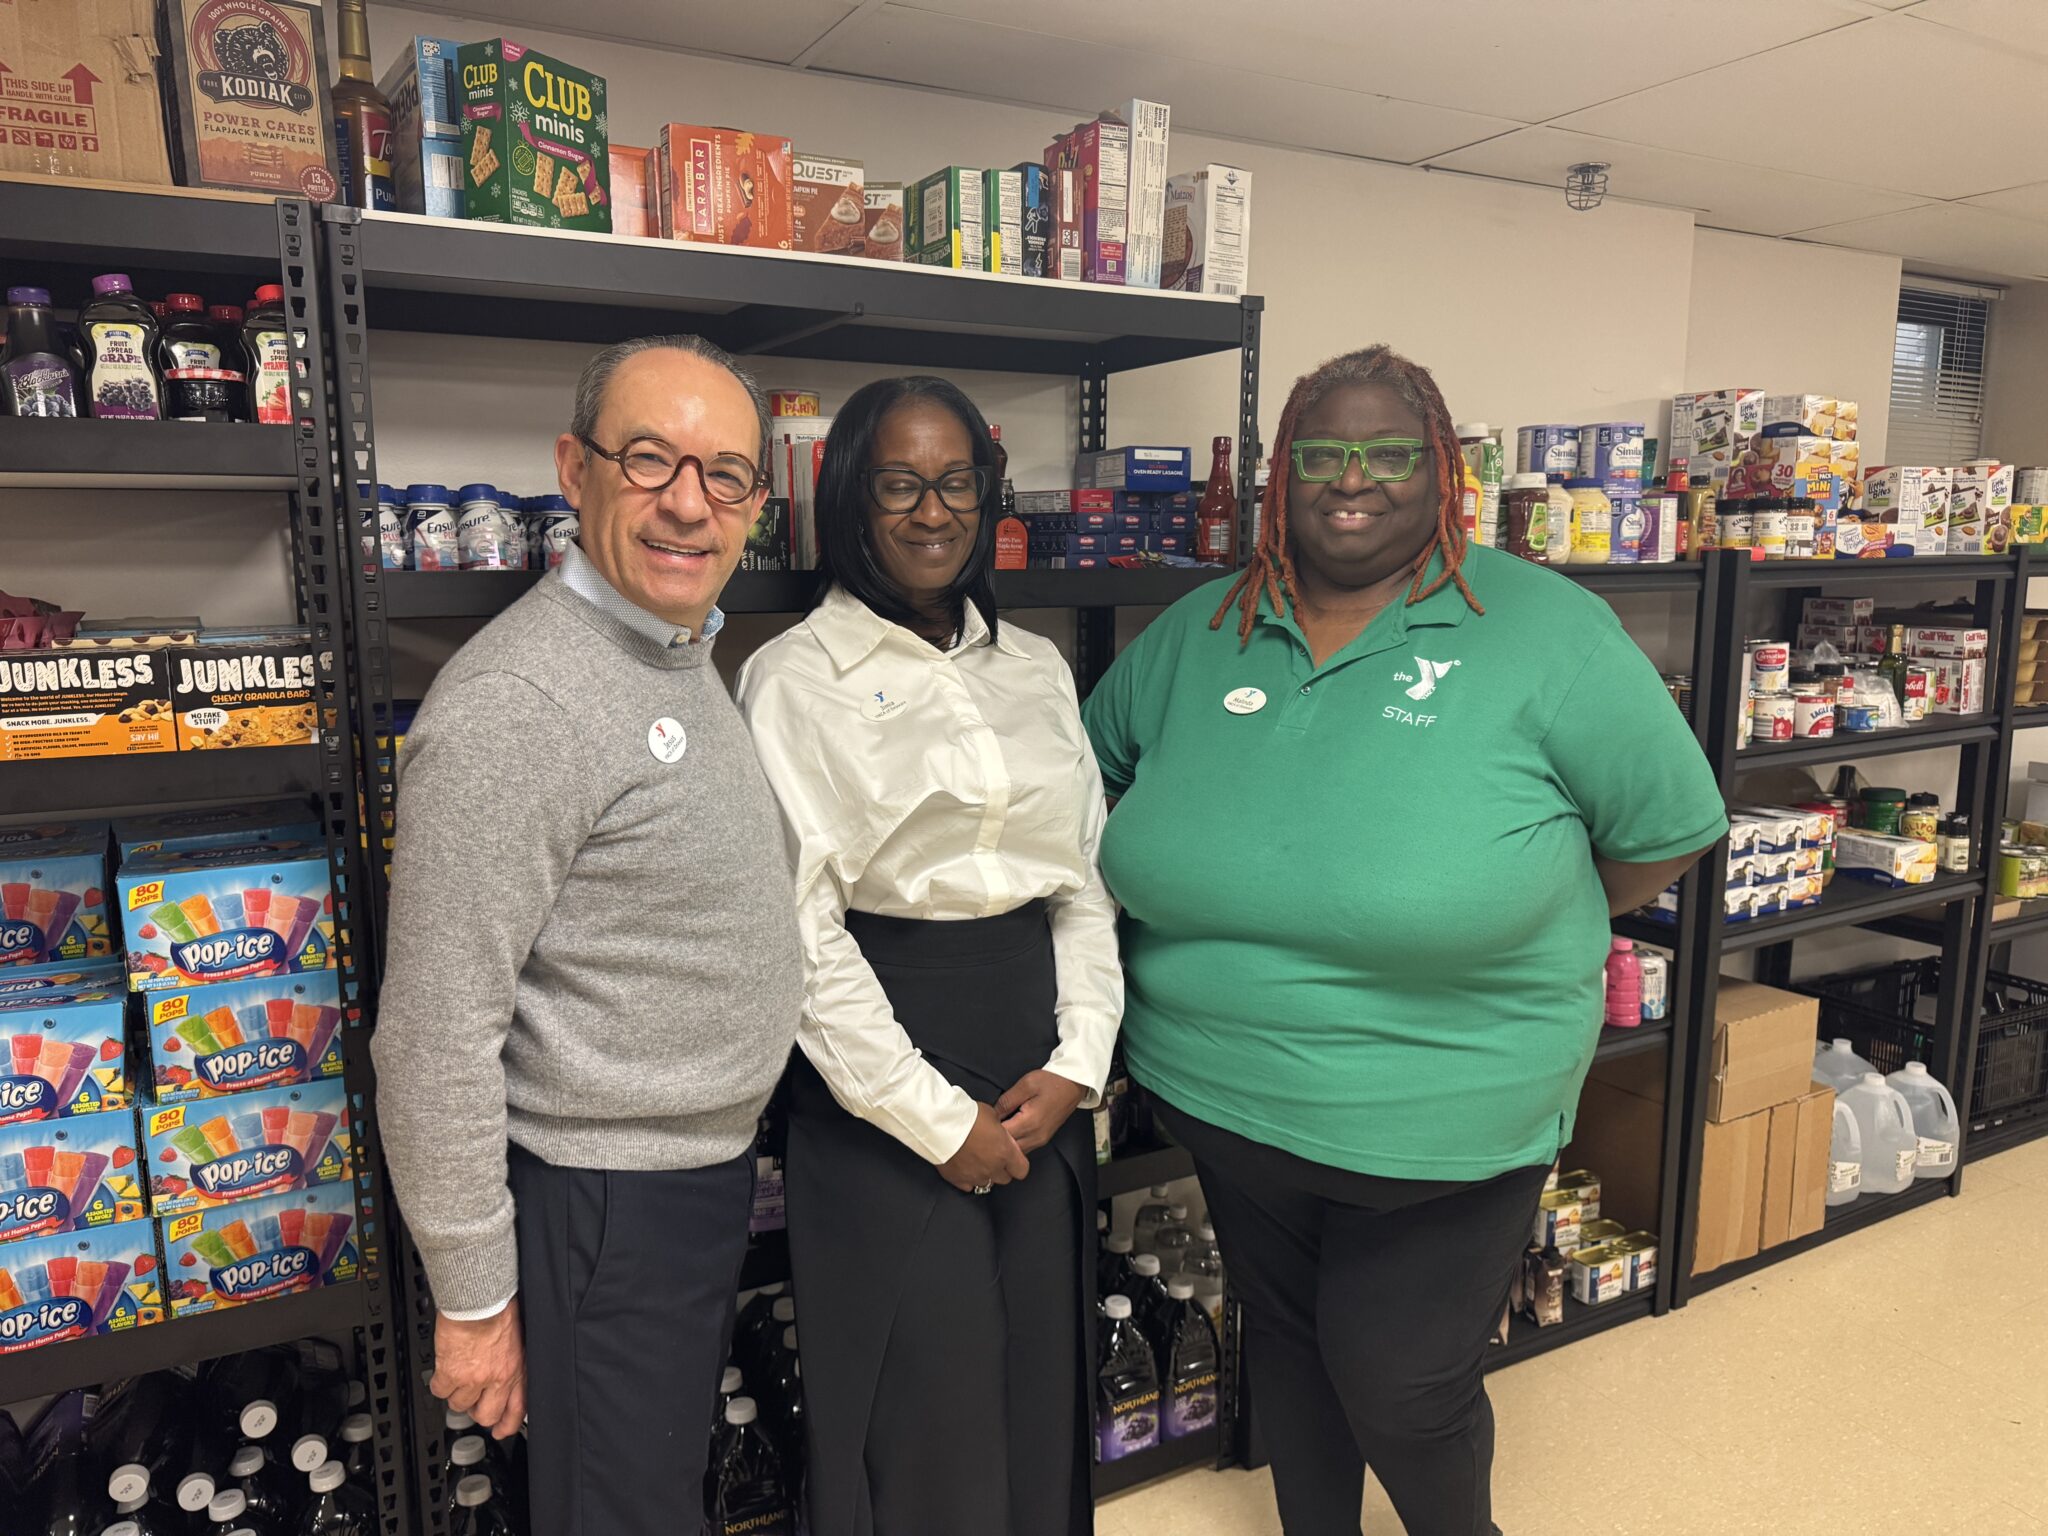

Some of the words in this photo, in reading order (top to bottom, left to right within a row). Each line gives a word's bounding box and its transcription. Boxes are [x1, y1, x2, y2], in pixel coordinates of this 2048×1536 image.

[208, 6, 225, 20] 100%
[224, 2, 256, 11] WHOLE
[258, 8, 289, 33] GRAINS
[463, 63, 498, 89] CLUB
[4, 78, 28, 89] THIS
[31, 80, 56, 92] SIDE
[58, 84, 72, 94] UP
[220, 75, 294, 107] KODIAK
[468, 85, 494, 100] minis
[524, 61, 592, 121] CLUB
[6, 90, 34, 98] HANDLE
[35, 93, 53, 101] WITH
[204, 112, 261, 128] POWER
[266, 120, 315, 136] CAKES
[535, 113, 585, 144] minis
[204, 124, 250, 136] FLAPJACK
[261, 131, 297, 142] WAFFLE
[299, 137, 316, 145] MIX
[538, 141, 567, 155] Cinnamon
[567, 150, 585, 162] Sugar
[714, 134, 723, 190] INGREDIENTS
[793, 161, 842, 182] QUEST
[307, 184, 330, 193] PROTEIN
[695, 149, 707, 227] LARABAR
[792, 186, 810, 194] UMPKIN
[1170, 187, 1194, 202] Matzos
[716, 192, 724, 213] REAL
[778, 240, 789, 249] 6
[100, 354, 142, 363] GRAPE
[785, 401, 816, 414] PARTY
[1775, 464, 1794, 477] 30
[1807, 482, 1831, 493] MINI
[458, 514, 490, 531] nsure
[1828, 512, 1834, 520] 6
[380, 522, 401, 533] sure
[427, 522, 458, 534] Ensu
[553, 528, 580, 538] Ensu
[1918, 631, 1936, 641] Gulf
[1936, 632, 1955, 641] Wax
[0, 654, 154, 692] JUNKLESS
[1393, 671, 1413, 683] the
[211, 693, 244, 703] CHEWY
[244, 692, 286, 701] GRANOLA
[287, 690, 310, 698] BARS
[1382, 706, 1437, 728] STAFF
[136, 883, 159, 896] 80
[134, 893, 159, 905] POPS
[66, 935, 76, 944] 6
[182, 934, 273, 972] pop-ice
[306, 944, 316, 953] 6
[250, 961, 265, 970] Pops!
[161, 998, 184, 1011] 80
[159, 1008, 185, 1020] POPS
[205, 1043, 294, 1083] pop-ice
[327, 1052, 337, 1061] 6
[226, 1080, 246, 1089] Freeze
[254, 1075, 271, 1083] Home
[271, 1070, 286, 1079] Pops!
[79, 1092, 90, 1102] 6
[71, 1101, 100, 1110] ASSORTED
[16, 1109, 33, 1119] Pops!
[157, 1109, 180, 1123] 80
[155, 1119, 181, 1131] POPS
[323, 1156, 333, 1165] 6
[201, 1150, 289, 1190] pop-ice
[222, 1189, 242, 1197] Freeze
[250, 1183, 267, 1192] Home
[267, 1176, 283, 1186] Pops!
[93, 1200, 103, 1209] 6
[85, 1208, 114, 1218] ASSORTED
[87, 1214, 112, 1222] FLAVORS
[11, 1226, 29, 1236] Home
[30, 1219, 47, 1230] Pops!
[177, 1214, 199, 1229] 80
[175, 1225, 200, 1237] POPS
[339, 1256, 348, 1265] 6
[220, 1251, 305, 1293] pop-ice
[240, 1291, 260, 1299] Freeze
[268, 1283, 285, 1292] Home
[284, 1276, 299, 1287] Pops!
[115, 1307, 126, 1317] 6
[0, 1302, 77, 1338] op-ice
[108, 1314, 137, 1325] ASSORTED
[110, 1321, 135, 1329] FLAVORS
[4, 1344, 27, 1352] Freeze
[35, 1336, 54, 1345] Home
[54, 1328, 70, 1339] Pops!
[1174, 1373, 1216, 1395] NORTHLAN
